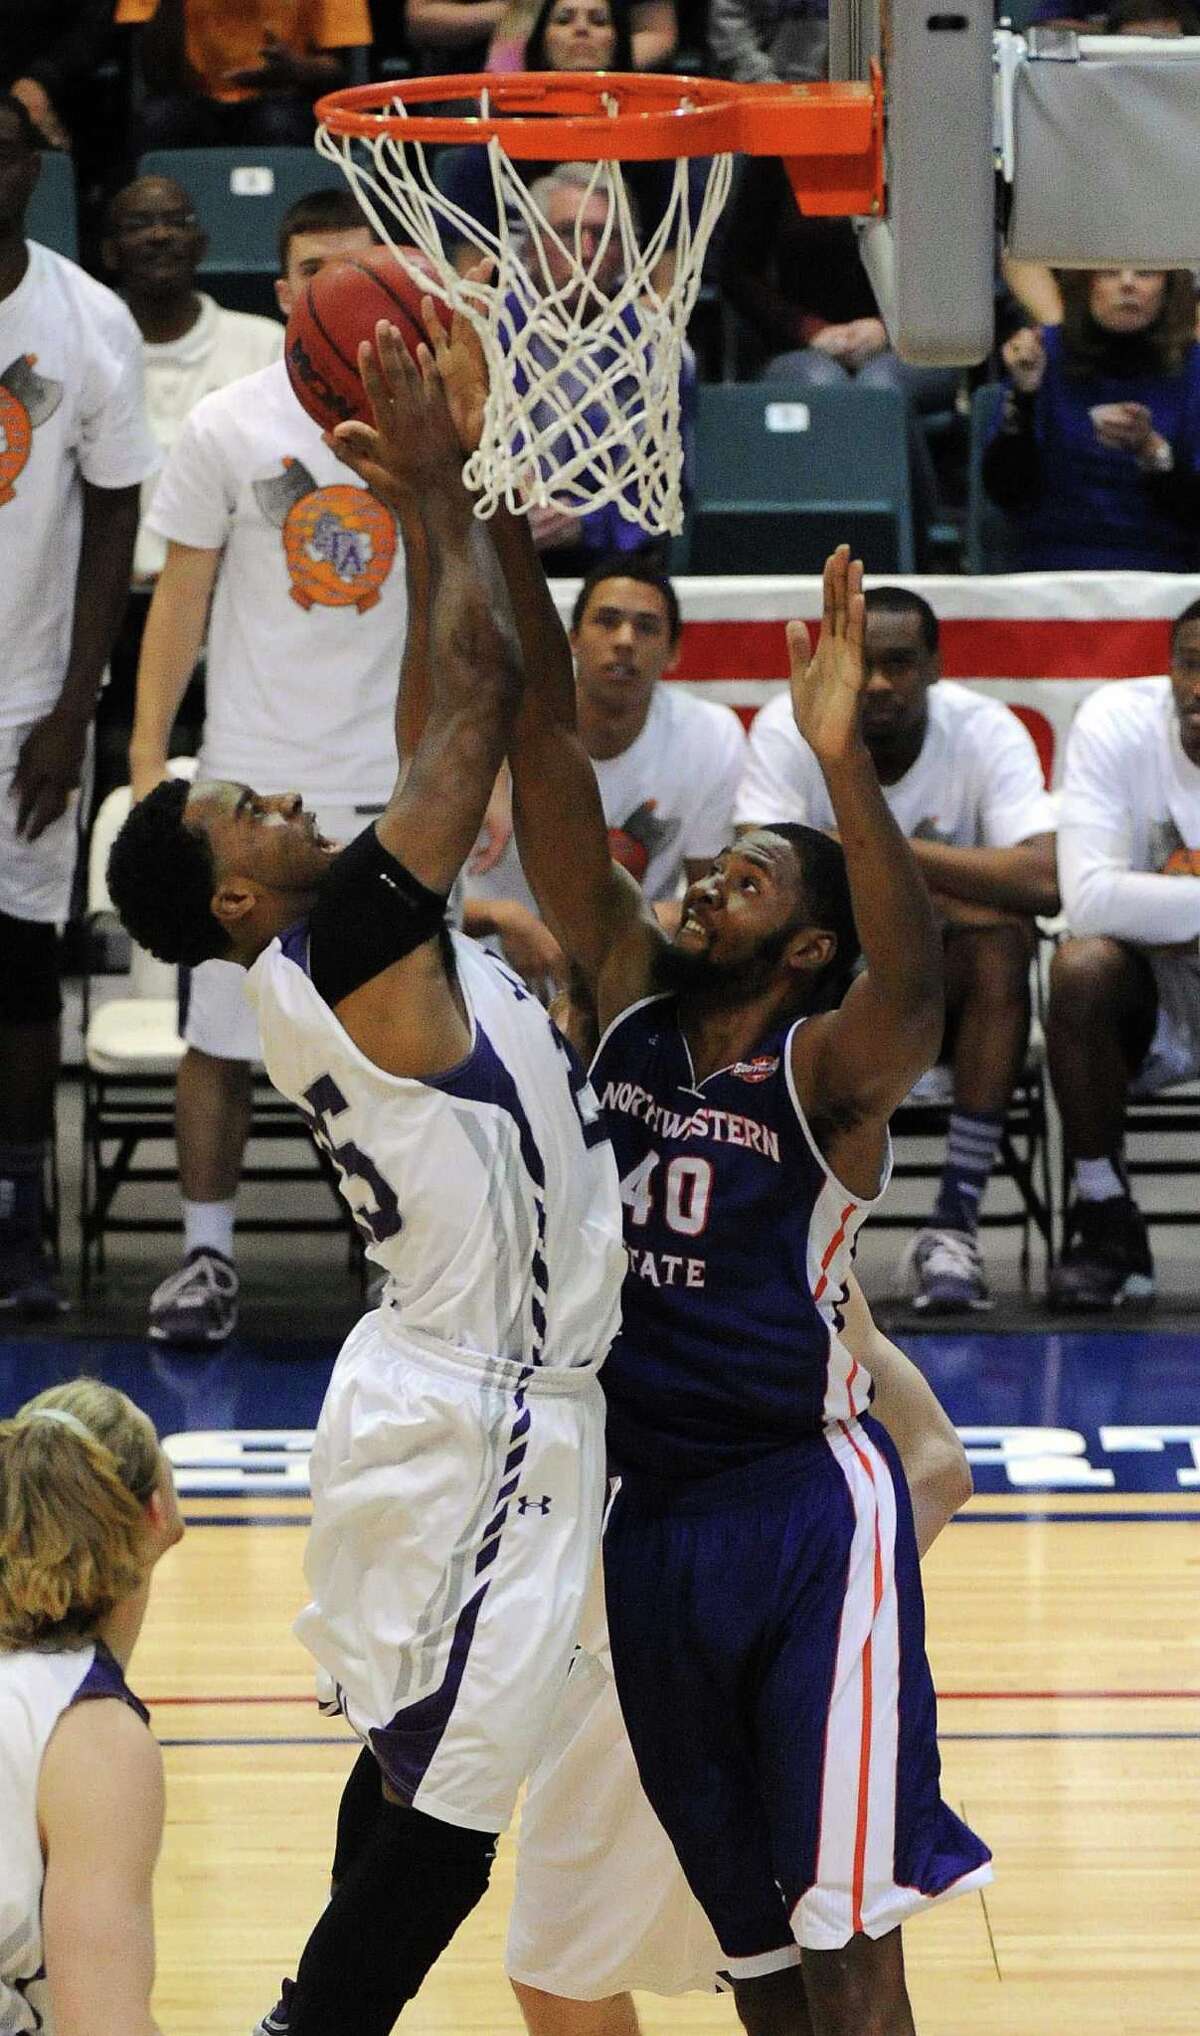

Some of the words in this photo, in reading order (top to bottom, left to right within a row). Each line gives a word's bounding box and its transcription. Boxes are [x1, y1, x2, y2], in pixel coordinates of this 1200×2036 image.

[600, 1081, 781, 1163] NORHWSTERN
[620, 1150, 713, 1237] 40
[626, 1246, 706, 1288] TATE
